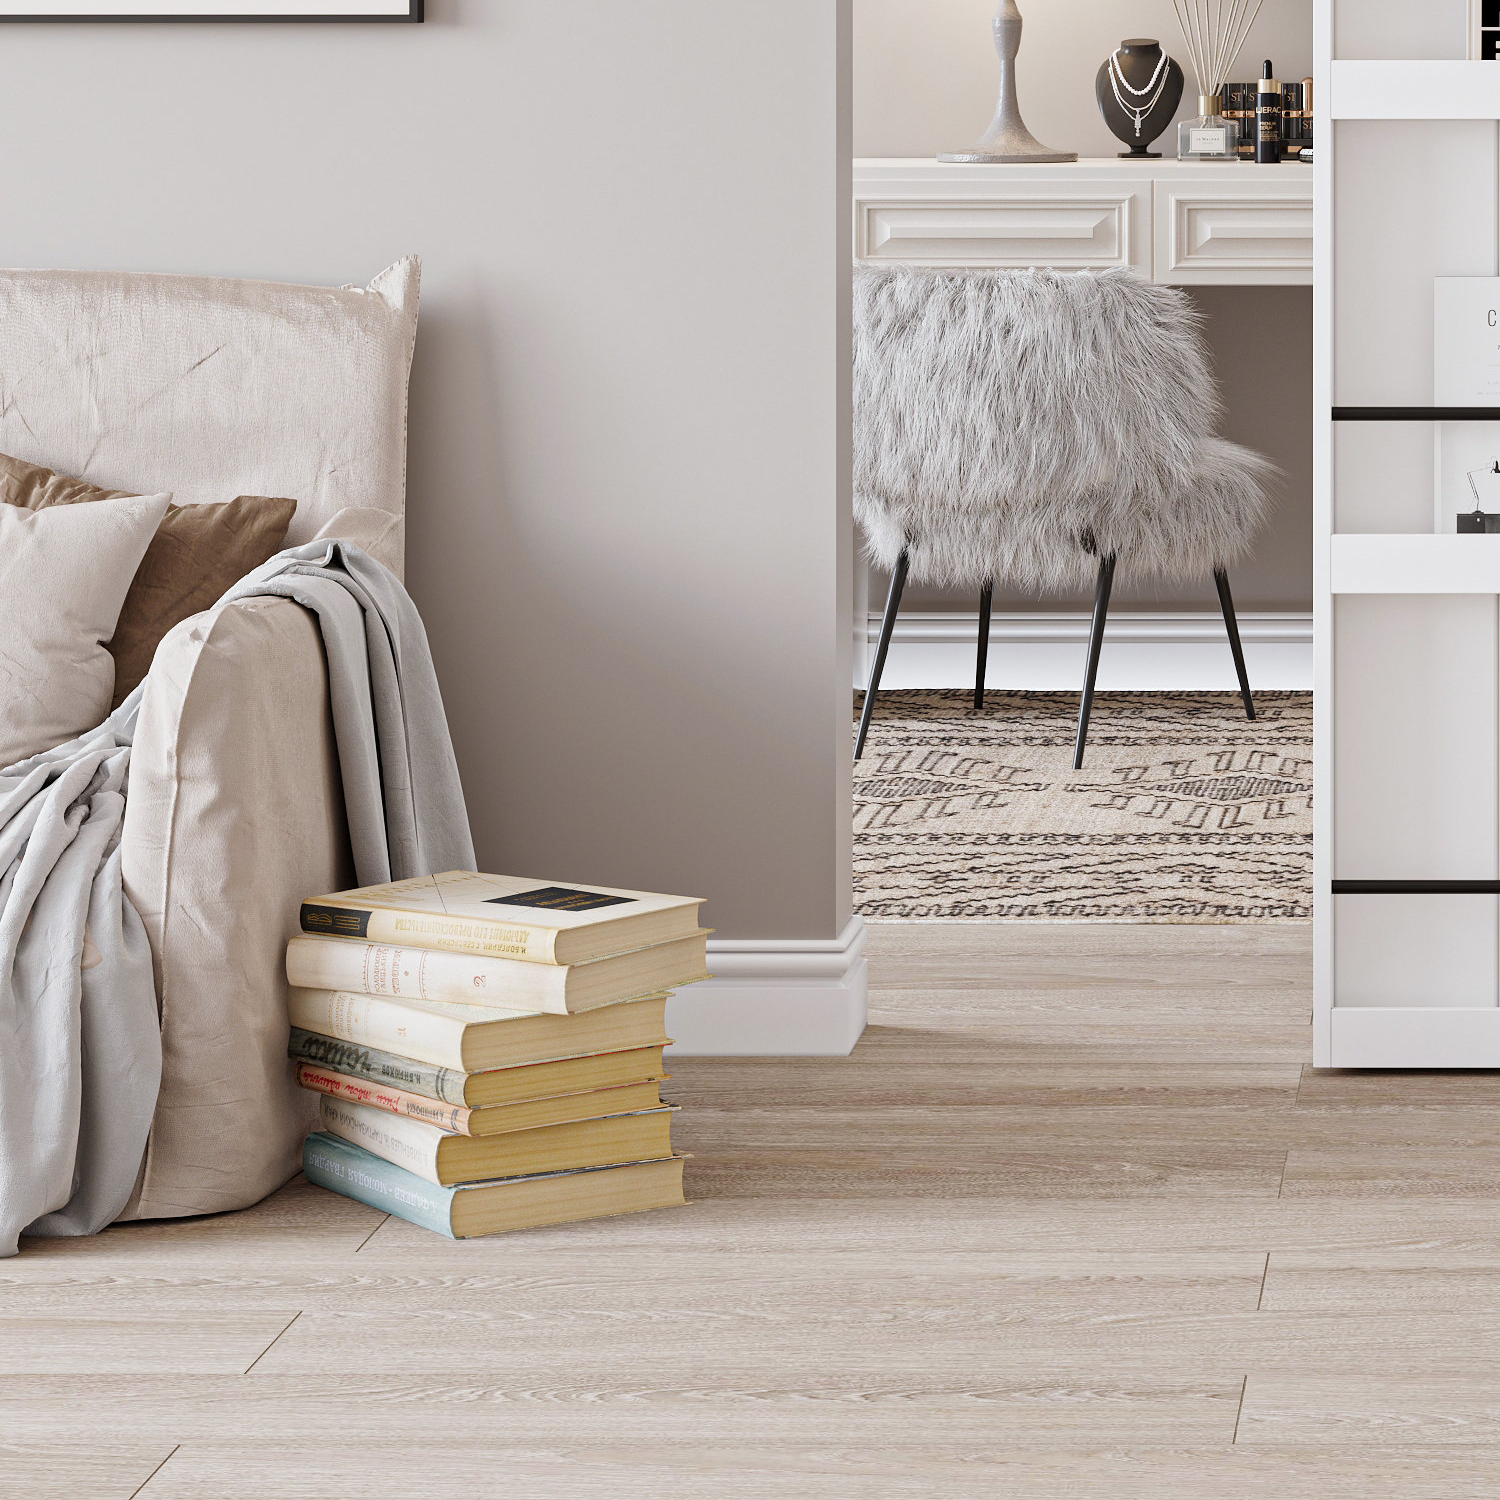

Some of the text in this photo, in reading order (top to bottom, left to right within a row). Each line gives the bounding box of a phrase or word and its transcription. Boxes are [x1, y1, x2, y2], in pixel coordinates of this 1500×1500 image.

[473, 975, 486, 987] 2
[308, 1153, 346, 1178] ГВАРДИЯ
[348, 1168, 387, 1194] МОЛОДАЯ
